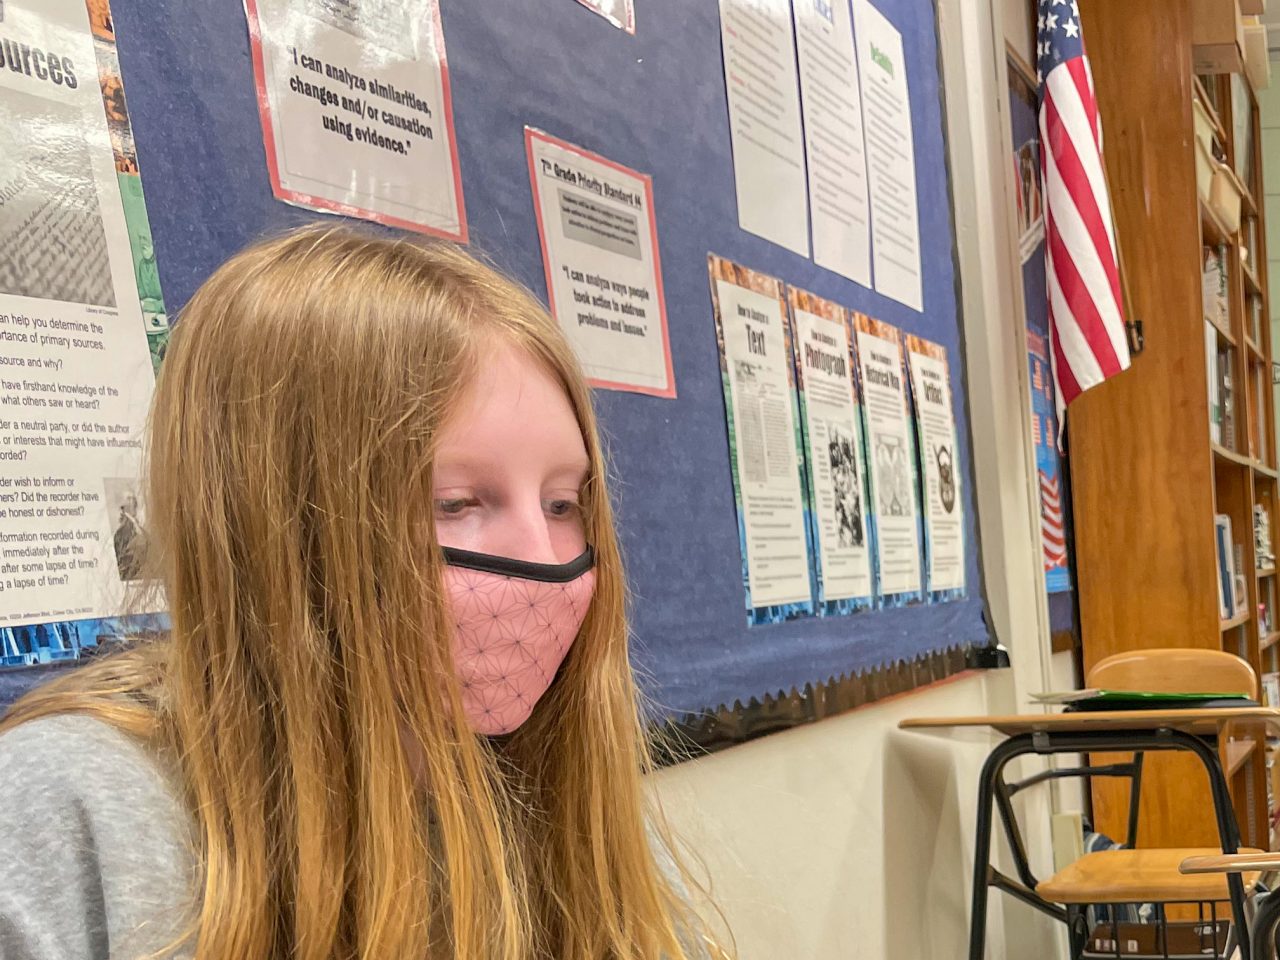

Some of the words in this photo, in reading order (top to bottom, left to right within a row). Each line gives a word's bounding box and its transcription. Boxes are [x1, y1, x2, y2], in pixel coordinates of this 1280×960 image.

[300, 53, 323, 74] can
[325, 63, 367, 91] analyze
[369, 78, 432, 118] similarities,
[289, 75, 340, 106] changes
[341, 95, 379, 121] and/or
[381, 110, 434, 140] causation
[322, 115, 354, 142] using
[355, 126, 411, 156] evidence."
[554, 163, 577, 184] Grade
[577, 171, 603, 195] Priority
[604, 182, 633, 205] Standard
[571, 270, 585, 283] can
[585, 272, 610, 291] analyze
[611, 281, 628, 296] ways
[628, 285, 650, 301] people
[11, 313, 30, 328] help
[32, 317, 48, 330] you
[49, 317, 89, 332] determine
[90, 322, 104, 334] the
[30, 333, 38, 343] of
[40, 334, 70, 349] primary
[72, 337, 106, 350] sources.
[745, 323, 767, 357] Text
[0, 356, 25, 367] source
[27, 357, 42, 368] and
[43, 358, 63, 371] why?
[804, 342, 847, 379] Photograph
[1, 379, 22, 391] have
[22, 380, 56, 393] firsthand
[57, 382, 97, 397] knowledge
[99, 385, 106, 396] of
[107, 386, 119, 397] the
[2, 395, 21, 406] what
[22, 395, 47, 407] others
[48, 397, 64, 408] saw
[65, 399, 73, 408] or
[75, 399, 100, 410] heard?
[13, 421, 19, 430] a
[20, 420, 48, 431] neutral
[71, 423, 80, 432] or
[81, 421, 93, 433] did
[94, 422, 107, 434] the
[108, 423, 130, 434] author
[2, 435, 11, 445] or
[13, 434, 46, 446] interests
[47, 434, 63, 446] that
[64, 435, 85, 449] might
[86, 435, 105, 447] have
[106, 436, 142, 449] influenced
[14, 476, 32, 487] wish
[33, 477, 41, 487] to
[42, 476, 66, 487] inform
[67, 478, 75, 487] or
[21, 491, 35, 502] Did
[35, 491, 48, 502] the
[50, 491, 79, 502] recorder
[81, 491, 100, 502] have
[8, 506, 35, 518] honest
[36, 508, 44, 517] or
[45, 506, 85, 517] dishonest?
[39, 529, 74, 541] recorded
[75, 528, 100, 542] during
[2, 545, 51, 558] immediately
[52, 543, 70, 555] after
[71, 543, 84, 555] the
[1, 561, 19, 574] after
[21, 561, 44, 573] some
[45, 560, 67, 573] lapse
[68, 559, 77, 569] of
[77, 558, 99, 569] time?
[6, 579, 12, 588] a
[14, 576, 36, 590] lapse
[37, 575, 46, 587] of
[47, 574, 69, 586] time?
